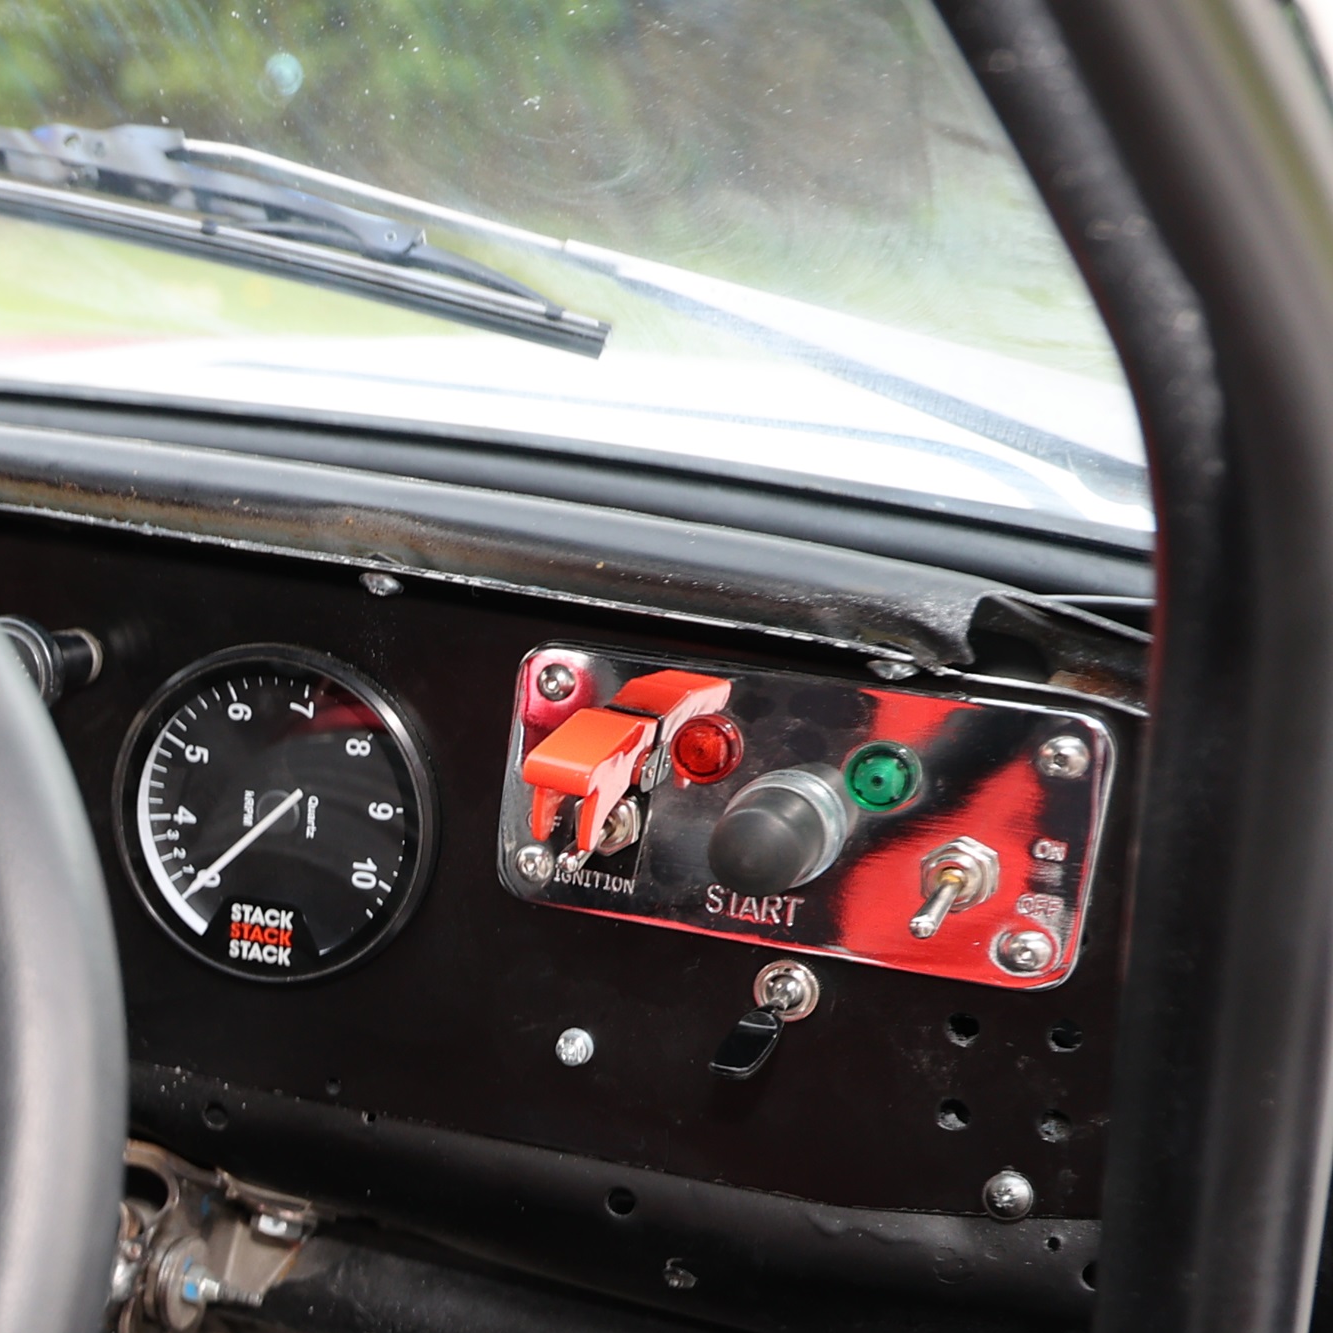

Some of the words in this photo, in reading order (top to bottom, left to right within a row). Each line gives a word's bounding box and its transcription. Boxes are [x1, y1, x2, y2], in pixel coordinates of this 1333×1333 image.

[227, 702, 252, 721] 6
[289, 701, 314, 719] 7
[185, 744, 209, 764] 5
[345, 738, 371, 757] 8
[173, 805, 197, 825] 4
[305, 794, 319, 839] Quartz
[368, 802, 394, 821] 9
[166, 828, 180, 841] 3
[173, 846, 187, 860] 2
[1032, 839, 1068, 862] ON
[182, 864, 195, 874] 1
[351, 857, 378, 890] 10
[553, 863, 636, 895] IGNITION
[705, 884, 806, 927] START
[1016, 893, 1064, 917] OFF
[231, 902, 294, 931] STACK
[230, 921, 293, 947] STACK
[228, 938, 292, 967] STACK
